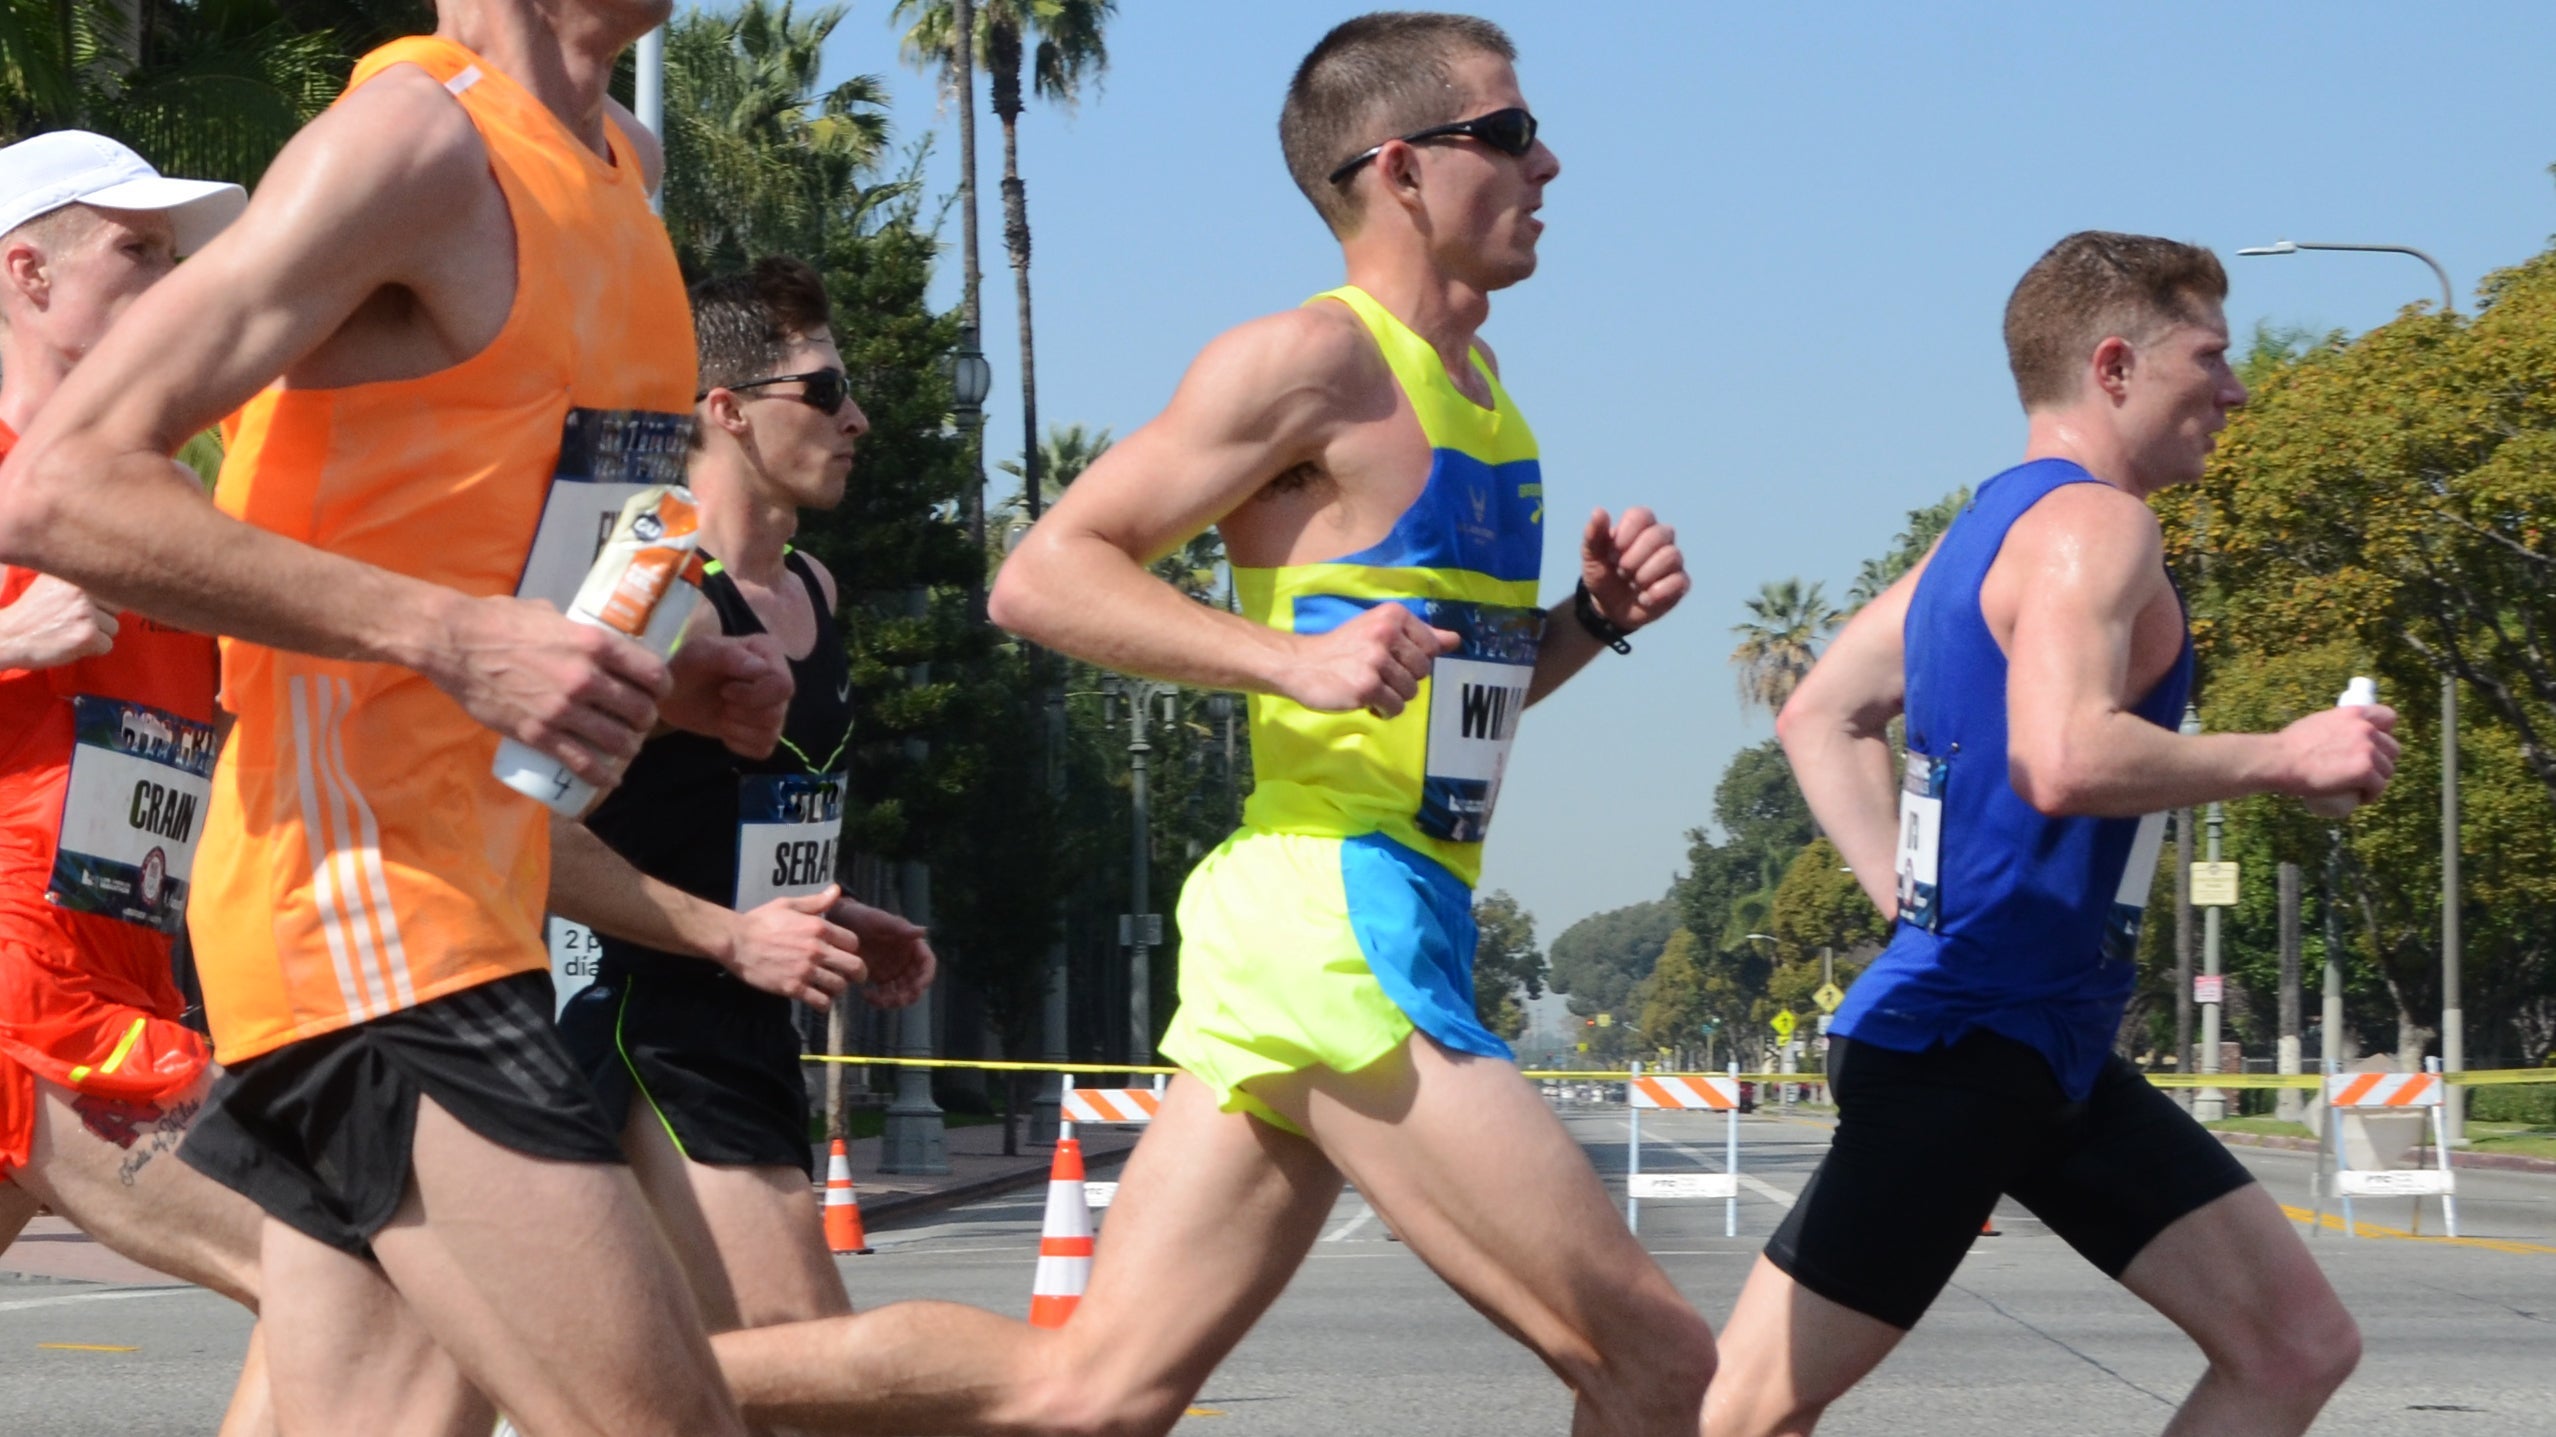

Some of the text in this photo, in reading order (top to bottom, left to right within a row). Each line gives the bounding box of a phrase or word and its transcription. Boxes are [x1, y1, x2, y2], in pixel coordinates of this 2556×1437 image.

[553, 767, 573, 800] 4
[129, 779, 198, 844] CRAIN
[565, 929, 579, 949] 2
